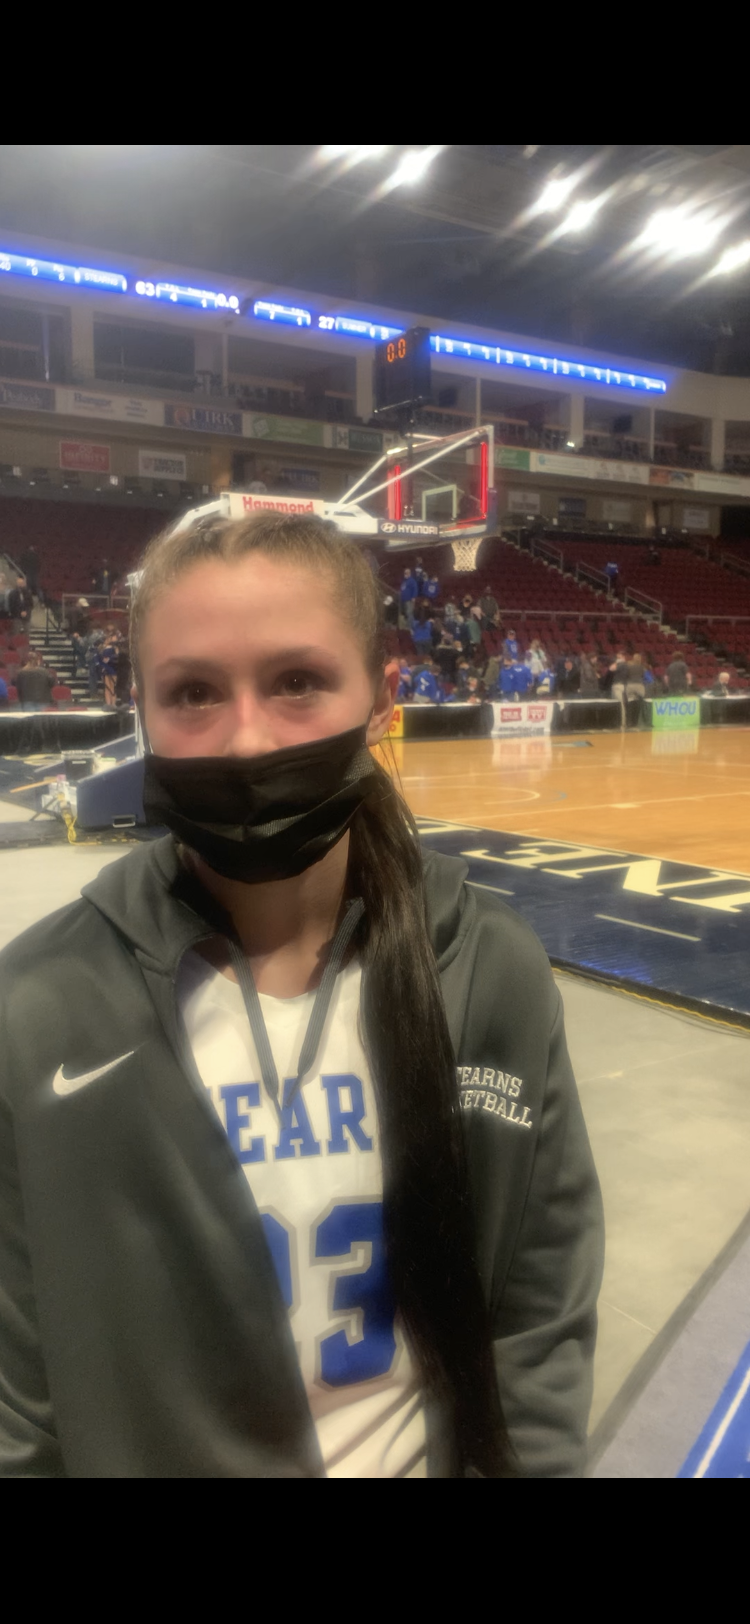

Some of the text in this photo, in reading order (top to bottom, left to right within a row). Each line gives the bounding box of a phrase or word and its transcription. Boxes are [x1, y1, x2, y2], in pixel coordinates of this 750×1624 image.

[135, 280, 155, 296] 63
[318, 316, 335, 329] 27
[387, 338, 406, 362] 0.0
[242, 496, 314, 513] Hammond
[397, 525, 438, 535] HYUNDAI
[655, 701, 697, 716] WHOU
[459, 1089, 533, 1128] ETBALL
[206, 1073, 374, 1166] EAR
